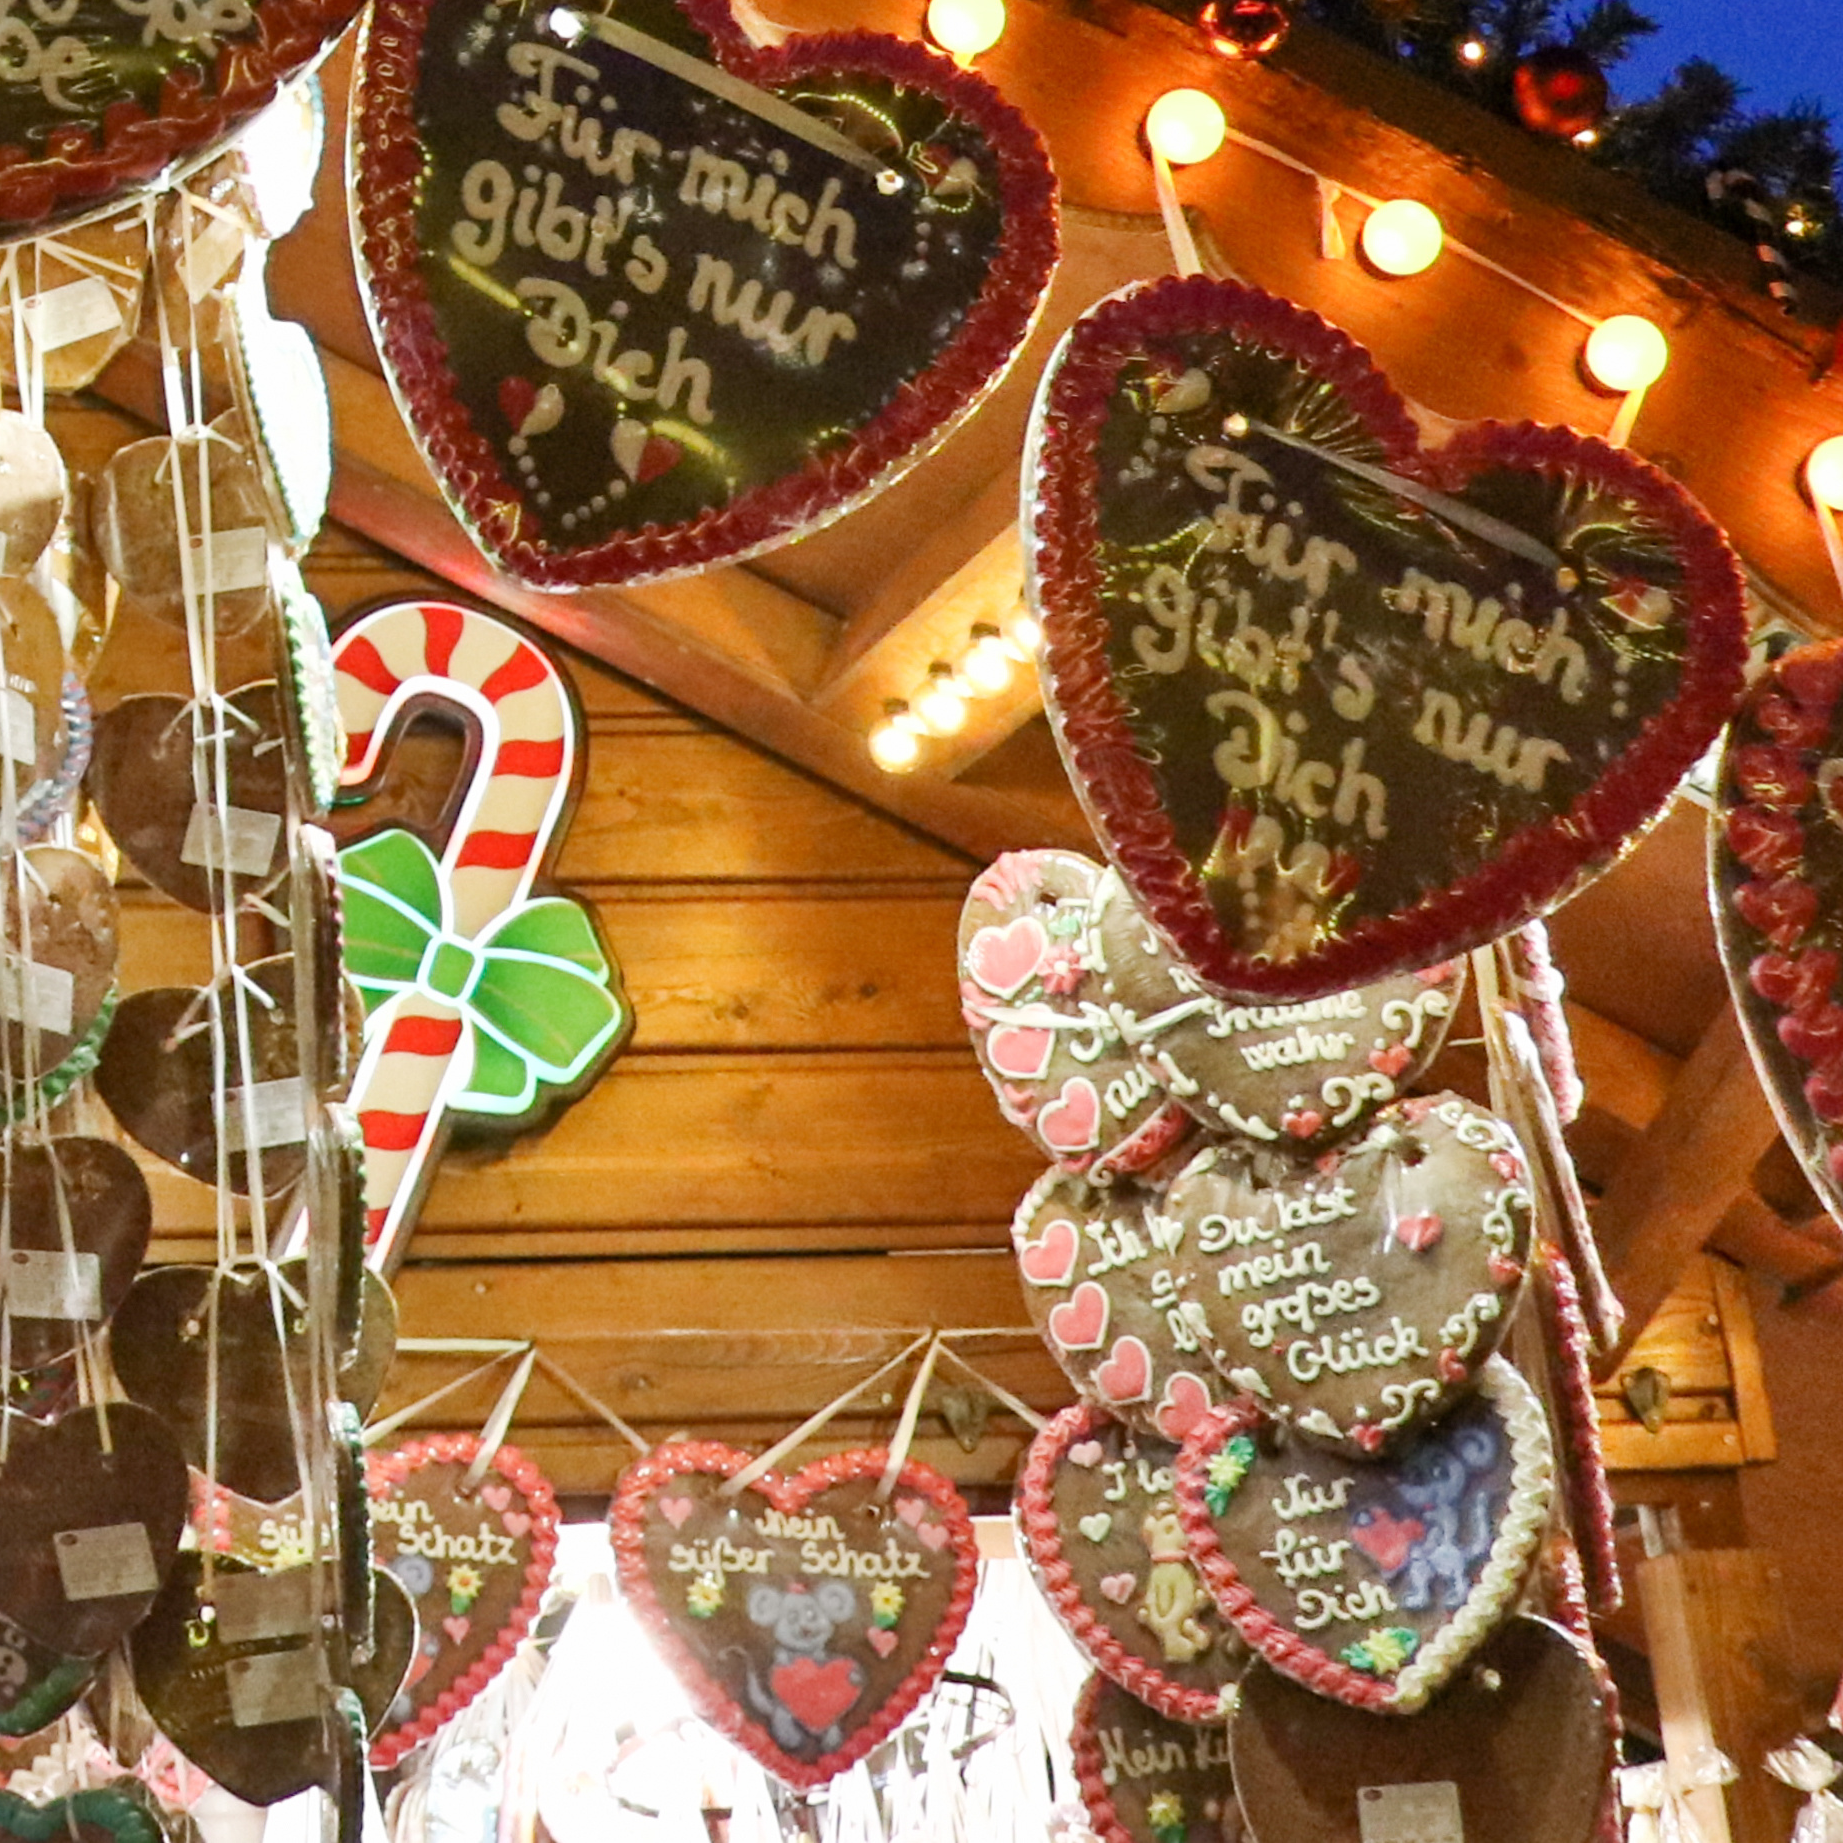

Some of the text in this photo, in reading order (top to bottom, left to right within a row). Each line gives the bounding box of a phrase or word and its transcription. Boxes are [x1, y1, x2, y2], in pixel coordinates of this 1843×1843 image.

[496, 42, 858, 268] Für mich
[451, 160, 858, 366] gibt's nur
[516, 277, 715, 424] Dich
[1186, 445, 1592, 704] Für mich
[1206, 690, 1390, 840] Dich
[1412, 690, 1570, 794] nur
[1240, 1026, 1357, 1073] wahr
[1197, 1213, 1276, 1254] Du
[1272, 1180, 1358, 1233] bist
[1216, 1237, 1333, 1297] mein
[1240, 1275, 1382, 1349] großes
[1286, 1315, 1431, 1383] Glück
[1135, 1457, 1176, 1496] lo
[1271, 1472, 1356, 1522] Nur
[396, 1521, 519, 1566] Schatz
[755, 1506, 847, 1541] Mein
[668, 1538, 932, 1588] süßer Schatz
[1259, 1526, 1352, 1589] für
[1293, 1579, 1398, 1631] Dich
[1097, 1725, 1188, 1786] Mein
